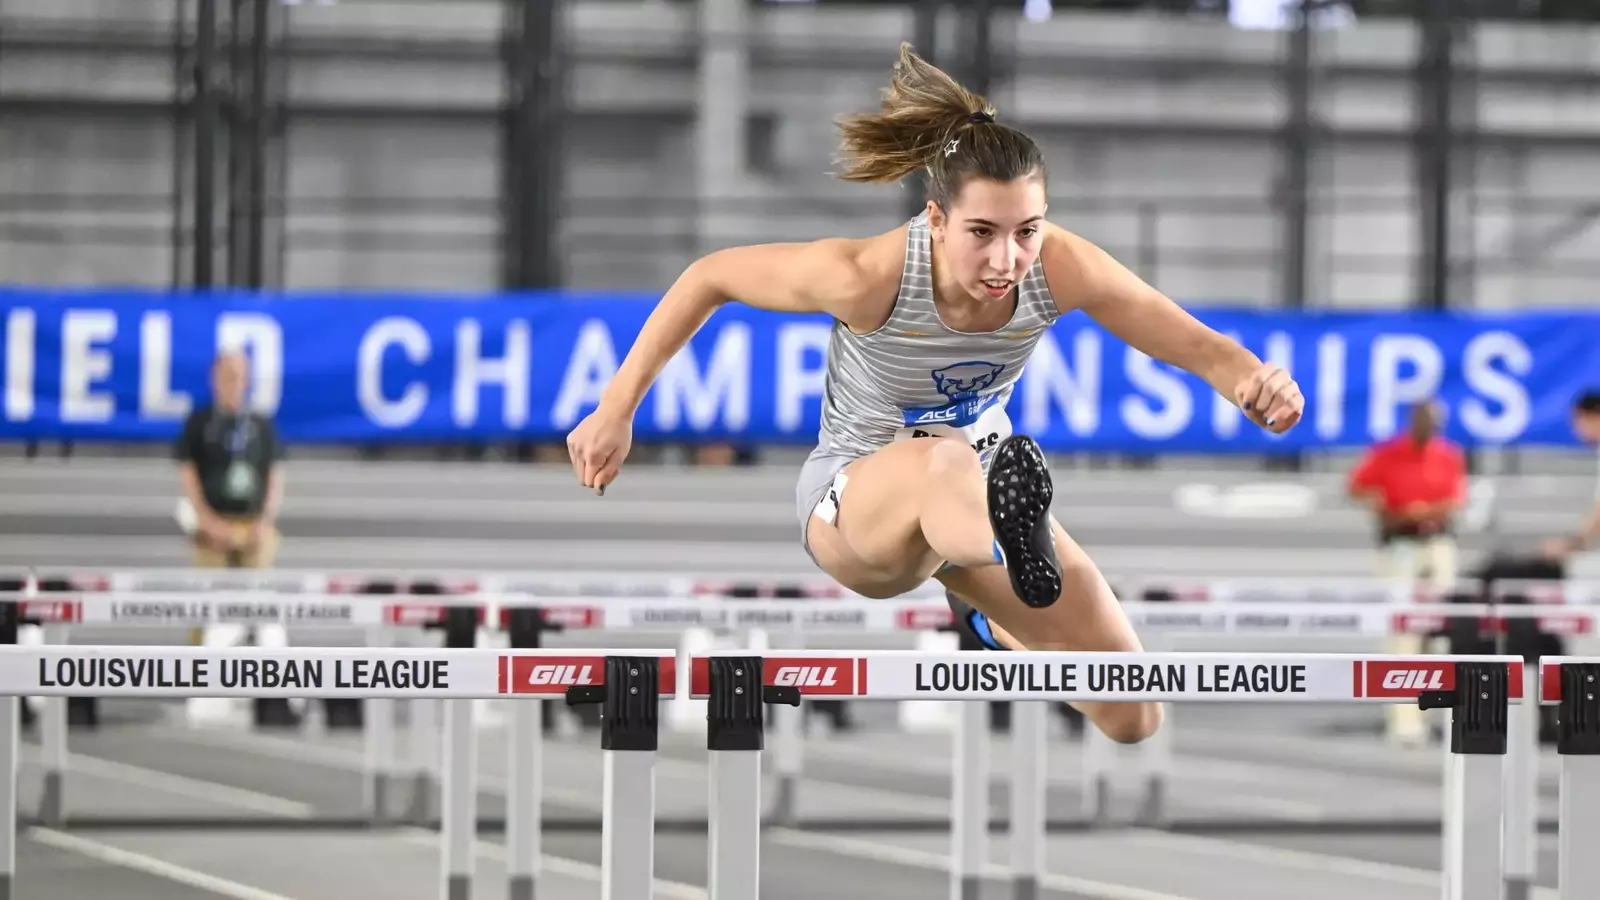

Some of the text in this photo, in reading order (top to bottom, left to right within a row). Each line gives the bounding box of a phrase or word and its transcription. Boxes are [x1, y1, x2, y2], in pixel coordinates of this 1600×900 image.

[918, 405, 957, 421] ACC
[39, 657, 449, 689] LOUISVILLE URBAN LEAGUE
[528, 664, 593, 685] GILL
[774, 666, 838, 687] GILL
[915, 662, 1306, 693] LOUISVILLE URBAN LEAGUE
[1382, 669, 1444, 689] GILL
